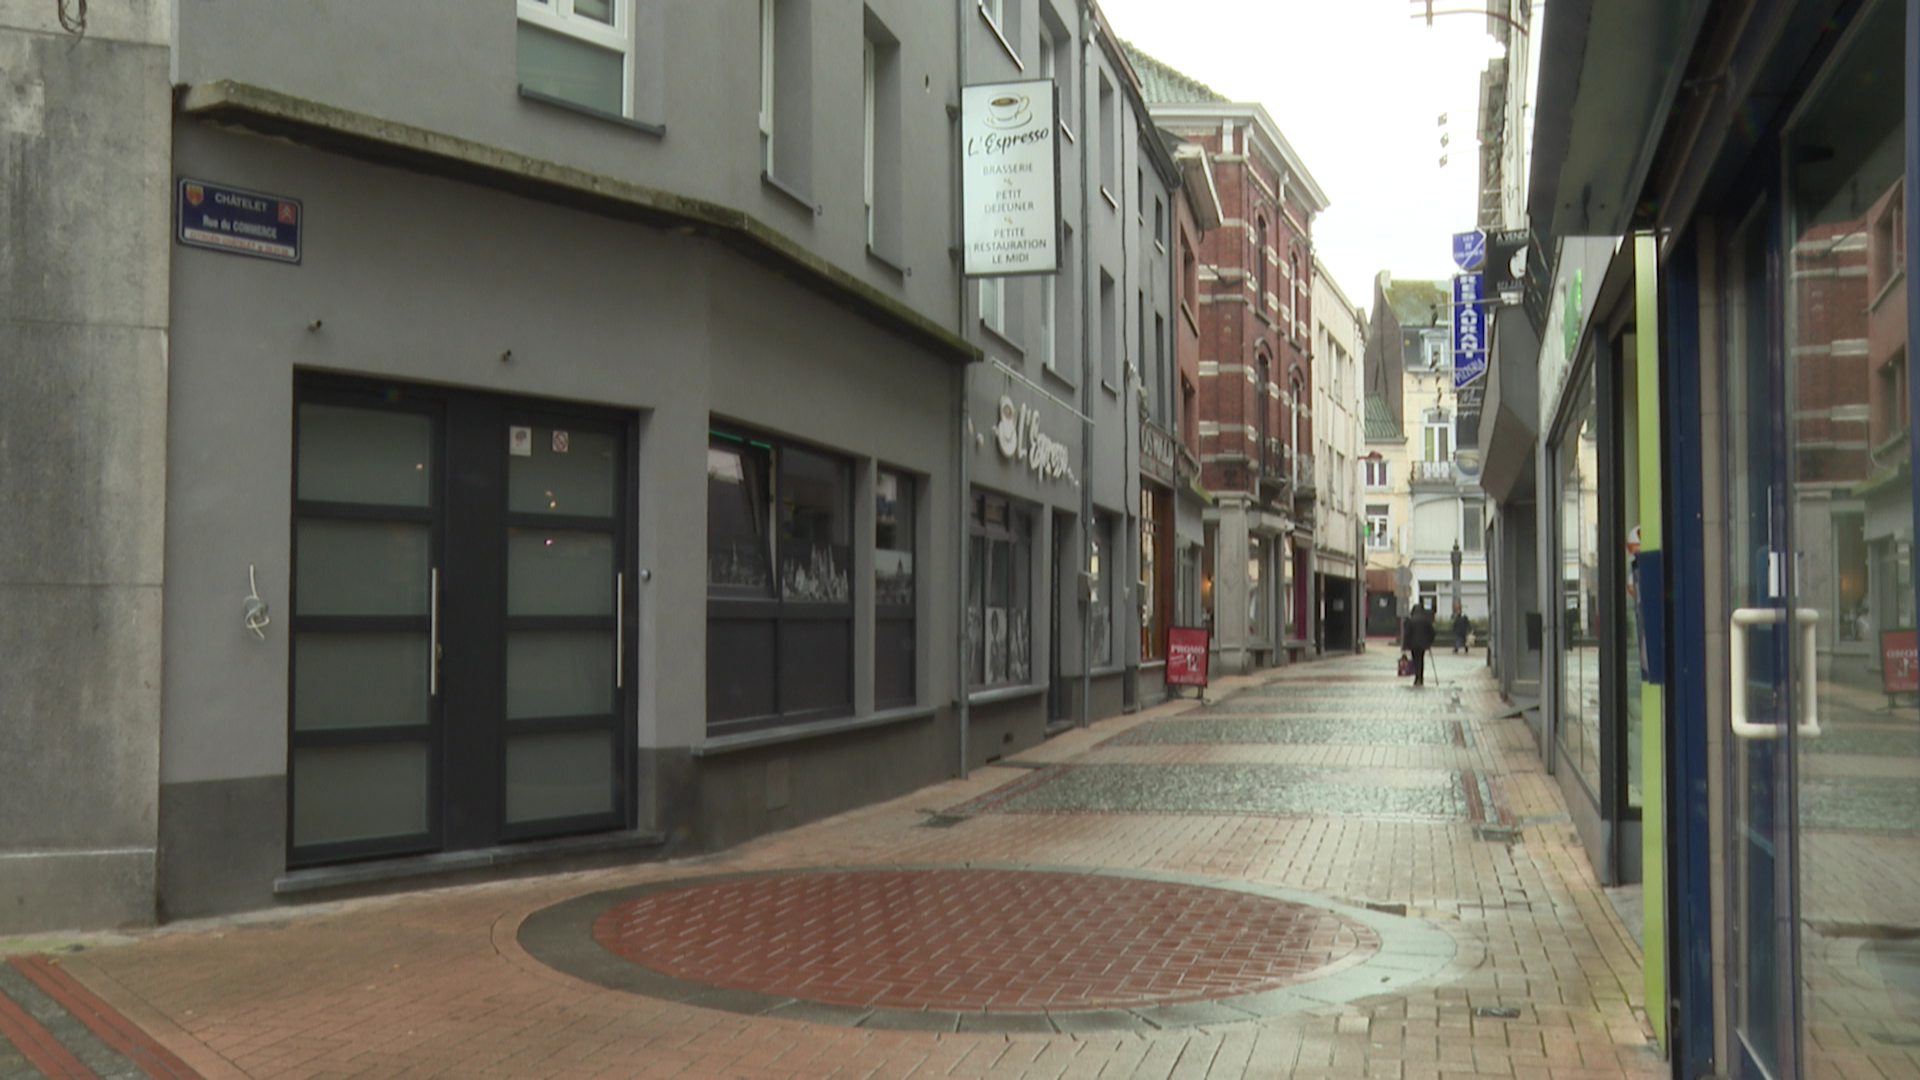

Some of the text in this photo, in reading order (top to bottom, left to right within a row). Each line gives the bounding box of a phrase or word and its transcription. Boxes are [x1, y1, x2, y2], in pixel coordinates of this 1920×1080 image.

[967, 127, 1049, 157] L'Espresso
[983, 163, 1033, 176] BRASSERIE
[996, 189, 1021, 201] PETIT
[215, 193, 267, 212] CHÂTELET
[202, 214, 277, 240] Rue du COMMERCE
[994, 227, 1024, 239] PETITE
[973, 239, 1047, 254] RESTAURATION
[992, 252, 1029, 265] LE MIDI
[1460, 276, 1479, 358] RESTAURANT
[1171, 645, 1205, 655] PROMO
